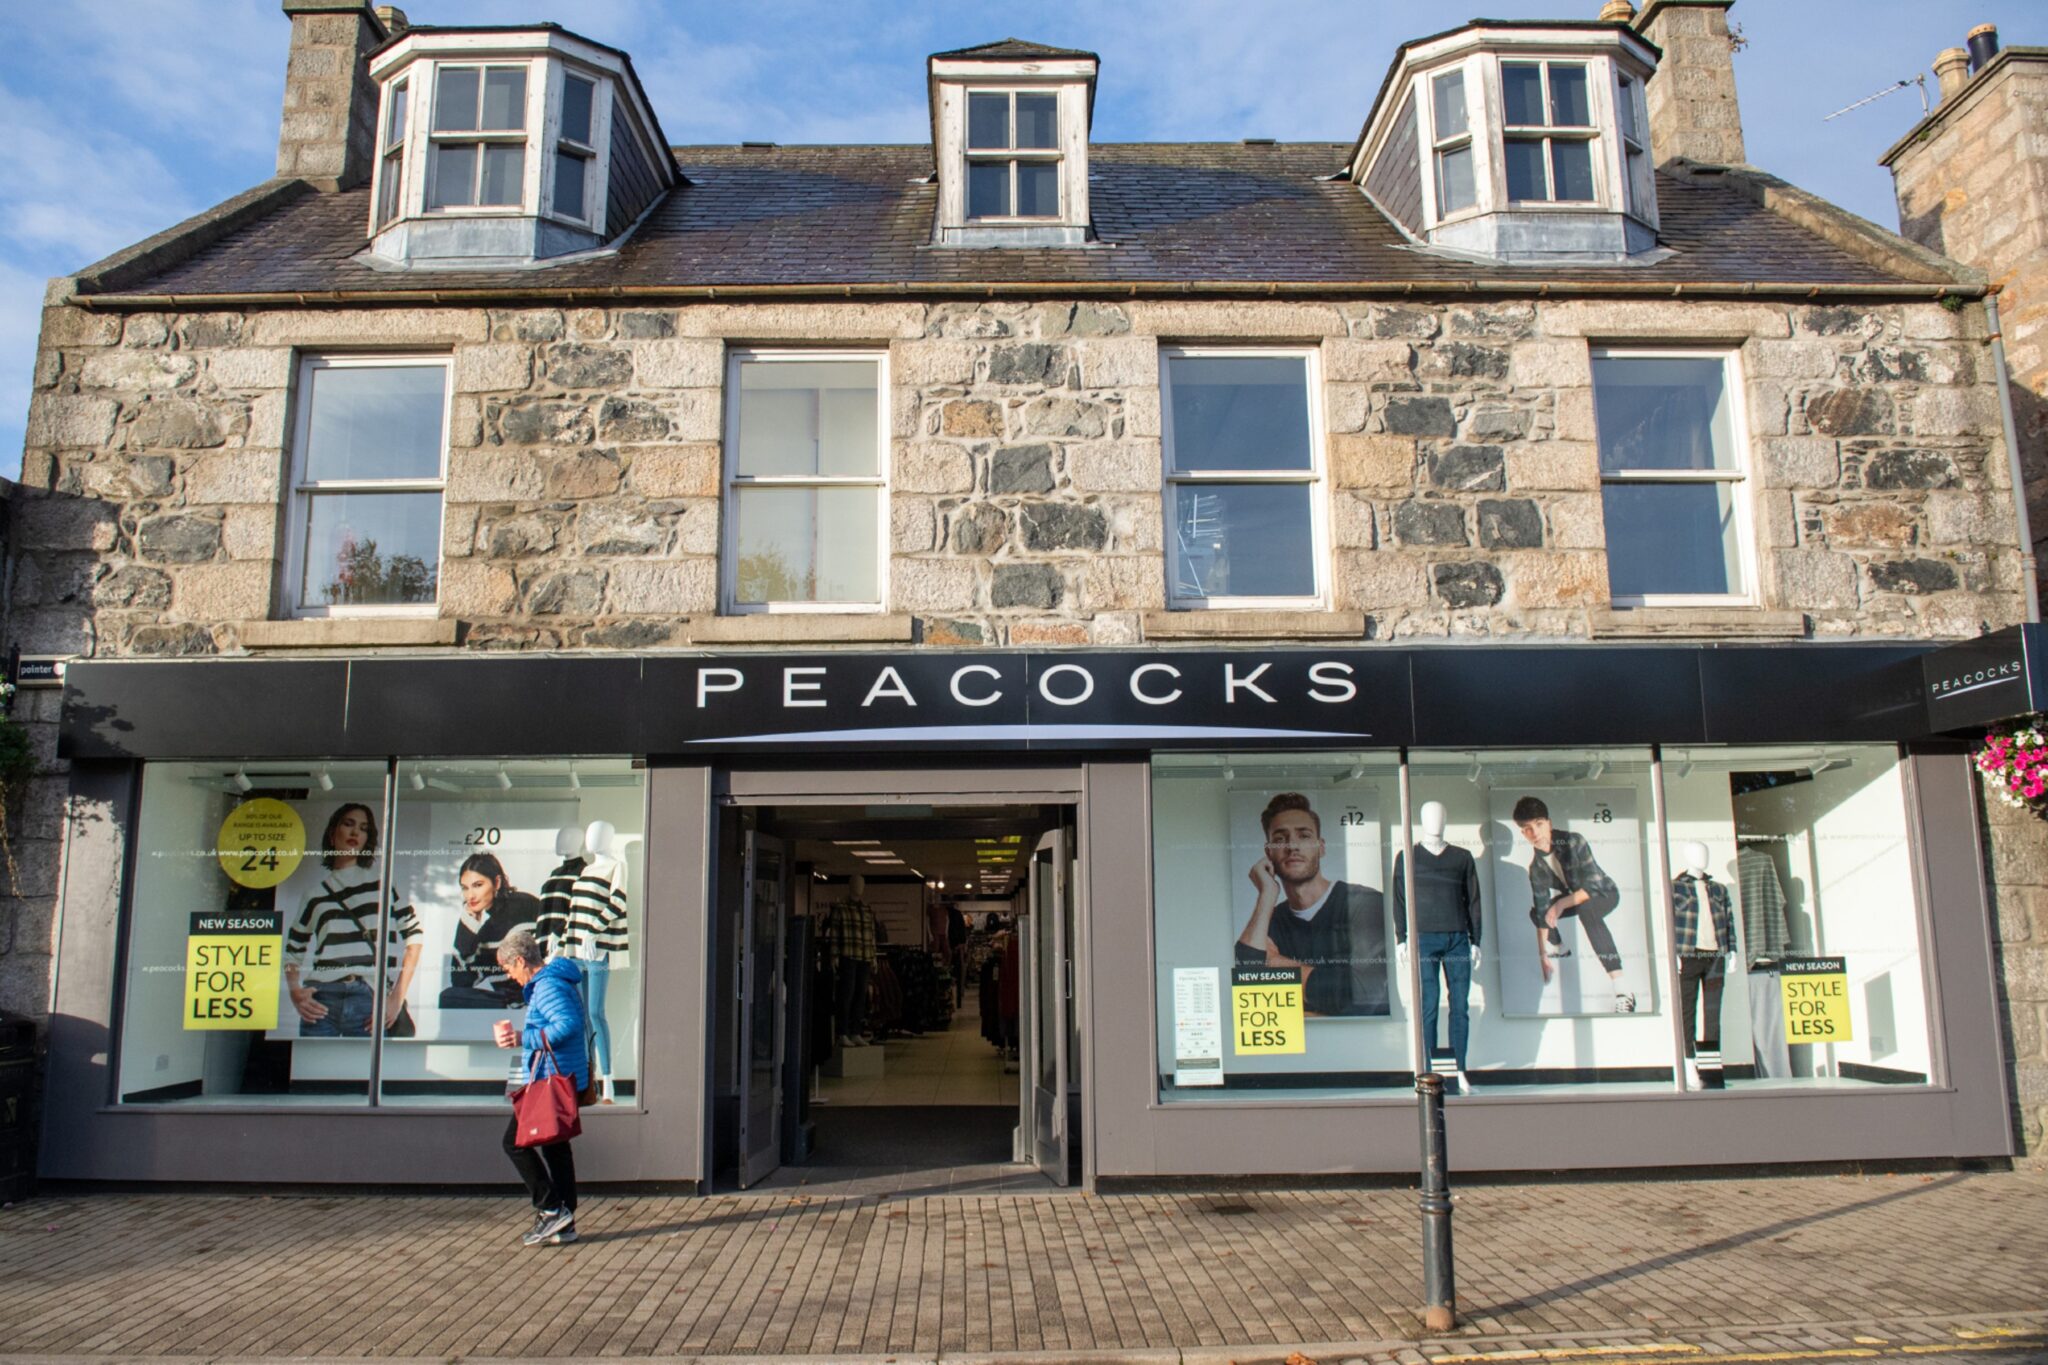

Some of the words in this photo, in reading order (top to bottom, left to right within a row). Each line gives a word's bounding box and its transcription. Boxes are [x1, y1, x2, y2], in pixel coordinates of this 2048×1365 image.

[21, 664, 52, 675] pointer
[1932, 661, 2021, 693] PEACOCKS
[697, 661, 1357, 708] PEACOCKS
[1339, 811, 1364, 826] £12
[1593, 808, 1612, 823] £8
[239, 833, 252, 841] UP
[254, 833, 266, 841] TO
[268, 833, 286, 841] SIZE
[464, 827, 501, 845] £20
[217, 848, 298, 858] www.peacocks.co.uk
[241, 845, 279, 872] 24
[199, 919, 226, 929] NEW
[227, 918, 274, 929] SEASON
[196, 945, 272, 966] STYLE
[1786, 962, 1805, 971] NEW
[1806, 961, 1840, 970] SEASON
[195, 971, 246, 992] FOR
[1238, 973, 1259, 981] NEW
[1260, 972, 1295, 980] SEASON
[1787, 981, 1842, 998] STYLE
[193, 997, 254, 1019] LESS
[1239, 991, 1296, 1009] STYLE
[1790, 1000, 1826, 1016] FOR
[1240, 1011, 1279, 1028] FOR
[1791, 1019, 1835, 1035] LESS
[1241, 1030, 1286, 1047] LESS
